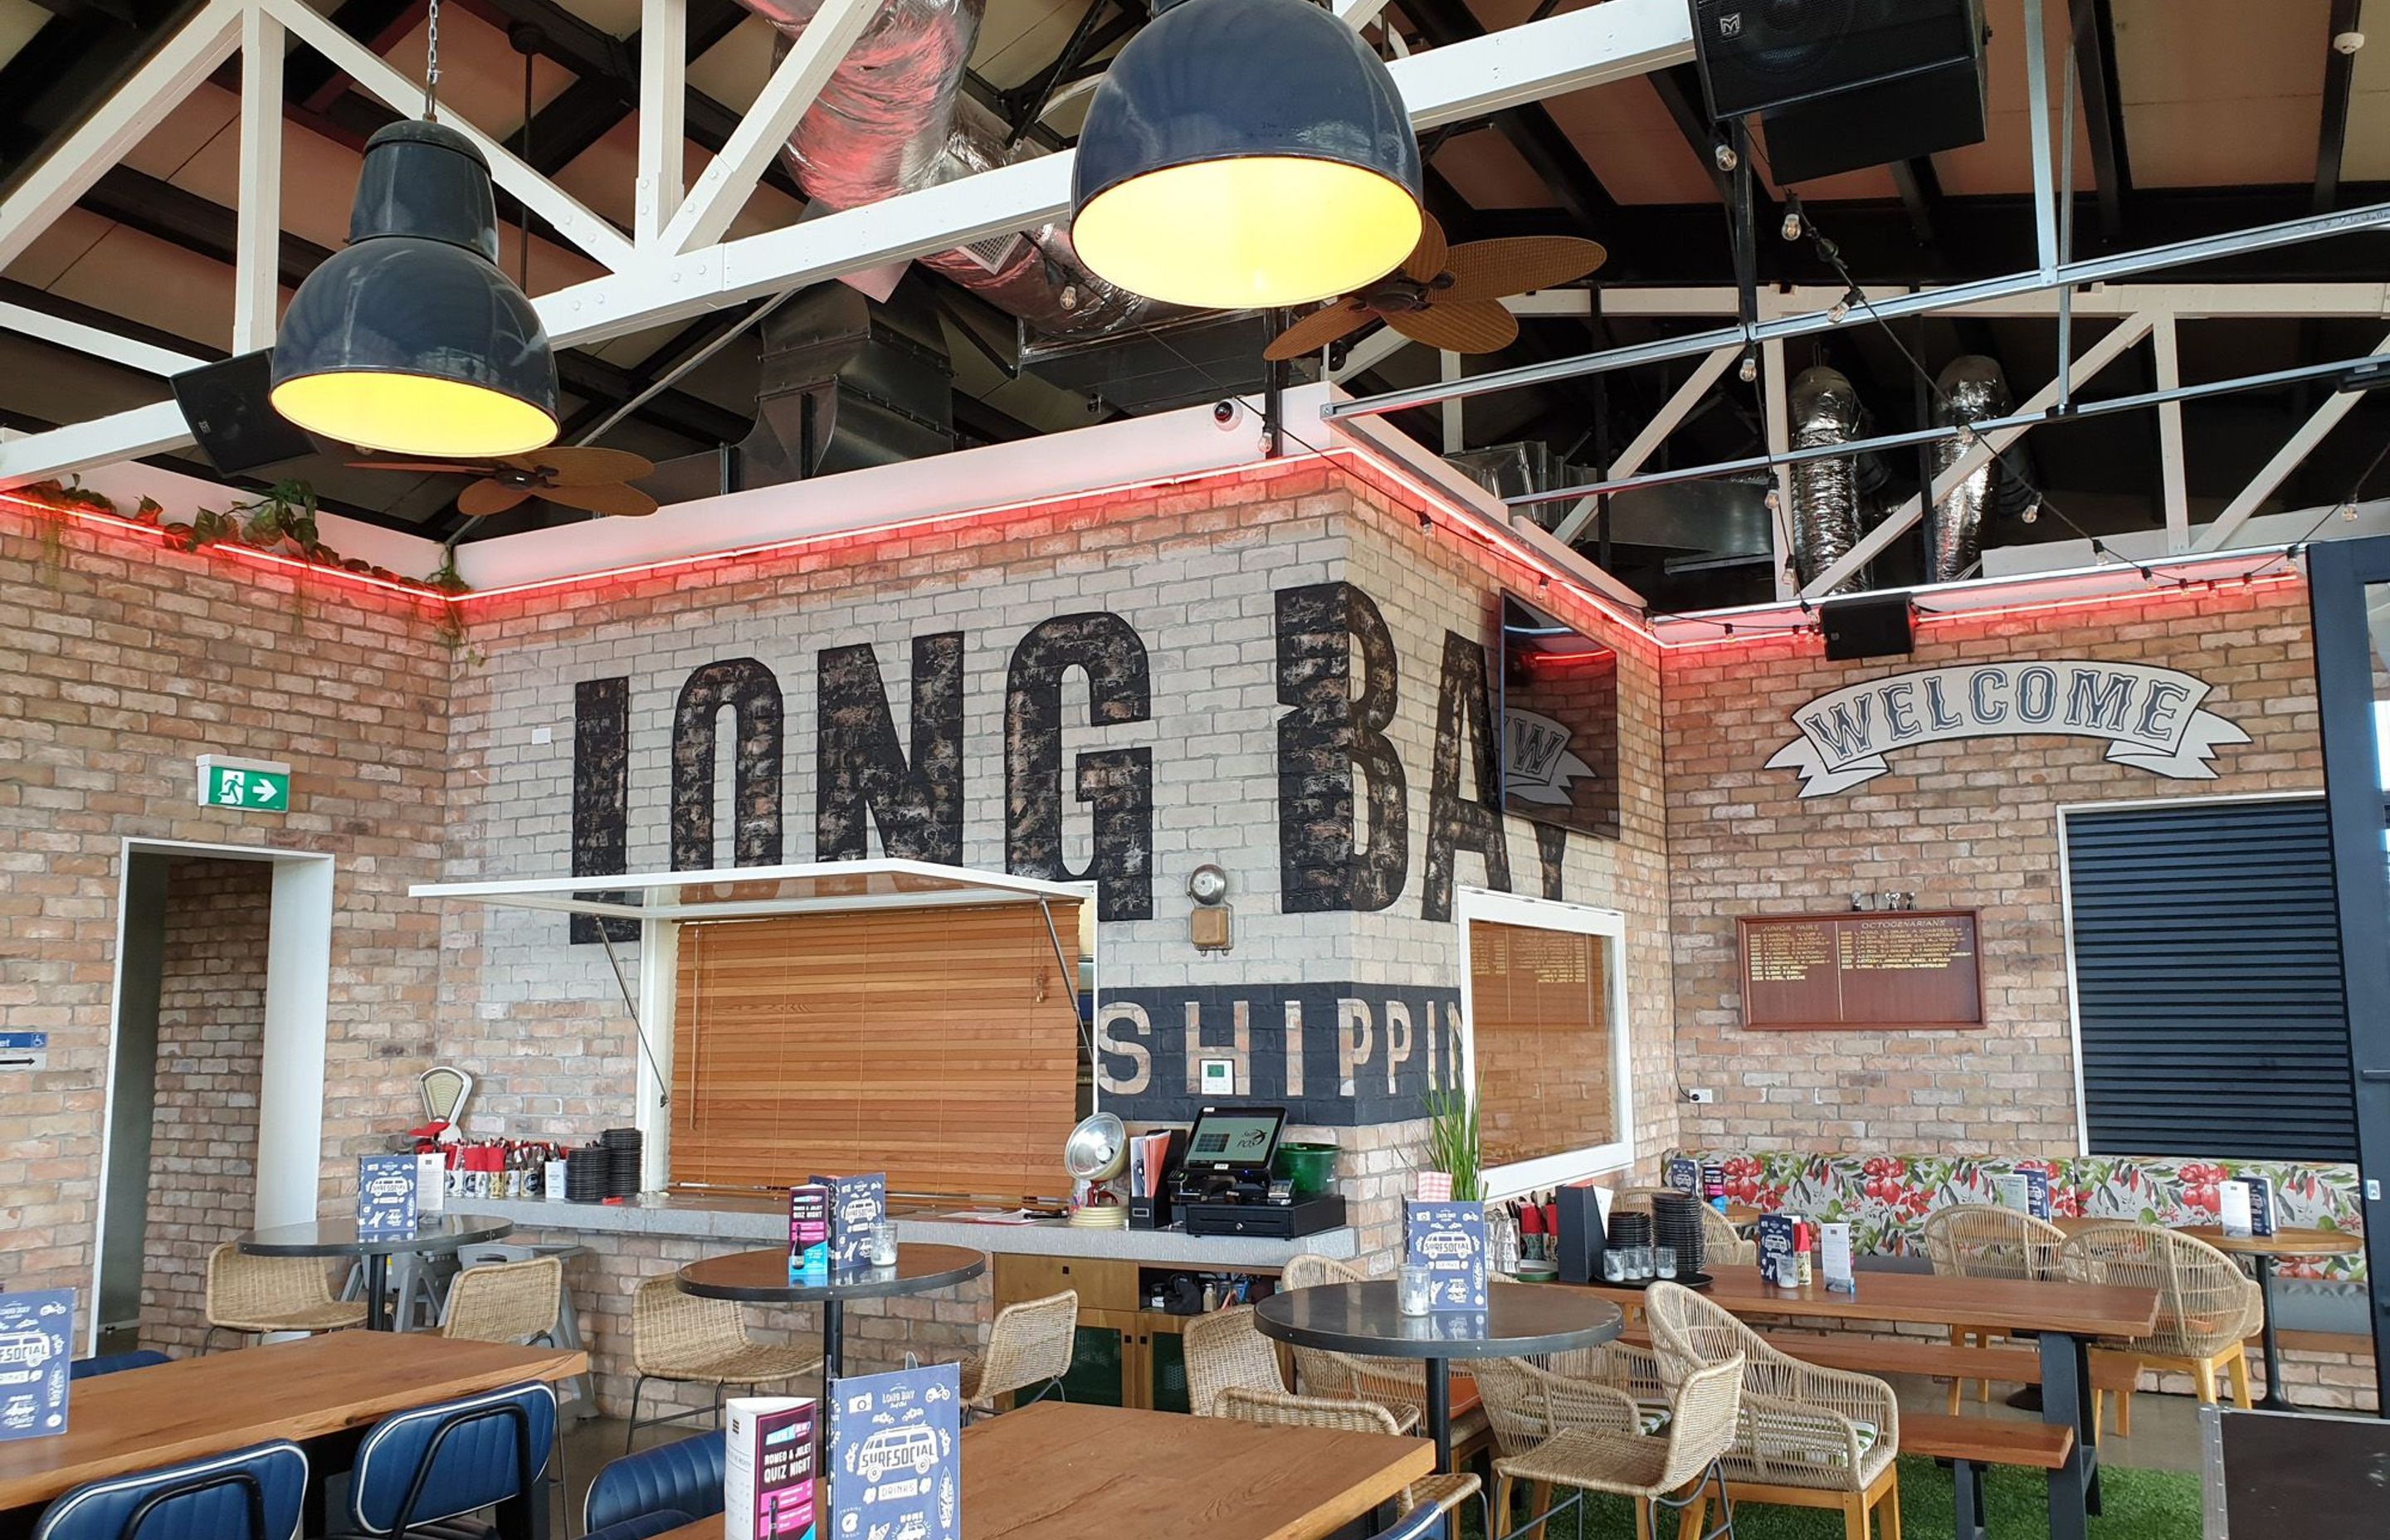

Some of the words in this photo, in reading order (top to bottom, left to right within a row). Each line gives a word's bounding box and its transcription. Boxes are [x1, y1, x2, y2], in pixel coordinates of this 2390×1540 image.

[1805, 667, 2189, 760] WELCOME
[764, 1451, 788, 1465] ROMEO
[789, 1450, 793, 1460] &
[861, 1444, 934, 1468] SURFSOCIAL
[763, 1465, 787, 1483] QUIZ
[790, 1456, 812, 1477] NIGHT
[881, 1484, 915, 1496] DRINKS
